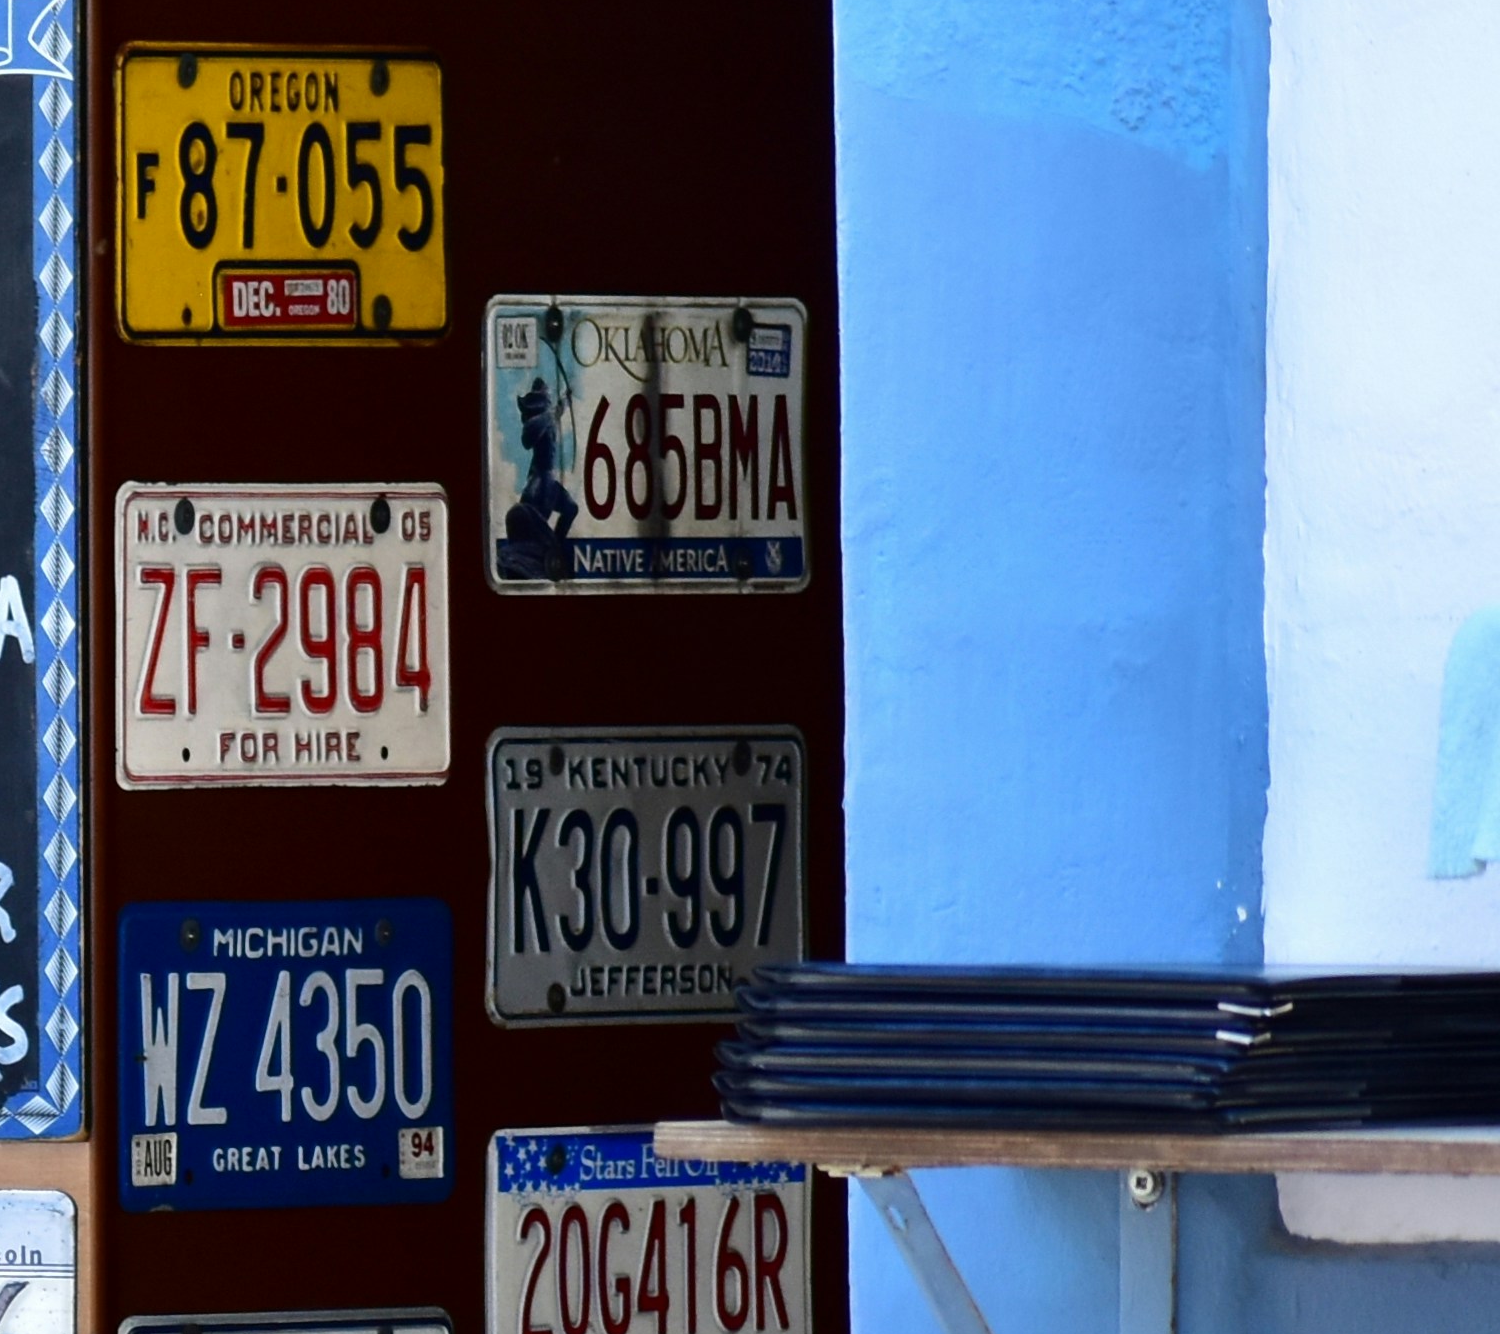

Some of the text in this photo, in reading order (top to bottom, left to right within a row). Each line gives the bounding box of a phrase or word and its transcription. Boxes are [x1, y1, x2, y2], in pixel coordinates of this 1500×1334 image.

[229, 70, 341, 114] OREGON
[135, 153, 160, 220] F
[232, 278, 351, 318] DEC. 80
[570, 317, 730, 383] OKLAHOMA
[136, 510, 433, 546] N.C. COMMERCIAL 05
[573, 544, 645, 574] NATIVE
[219, 731, 362, 764] FOR HIRE
[505, 754, 793, 792] 19 KENTUCKY 74
[212, 925, 364, 959] MICHIGAN
[569, 963, 734, 997] JEFFERSON
[139, 967, 434, 1127] WZ 4350
[143, 1137, 174, 1179] AUG
[212, 1145, 282, 1173] GREAT
[297, 1144, 366, 1172] LAKES
[410, 1130, 435, 1158] 94
[579, 1144, 635, 1180] Stars
